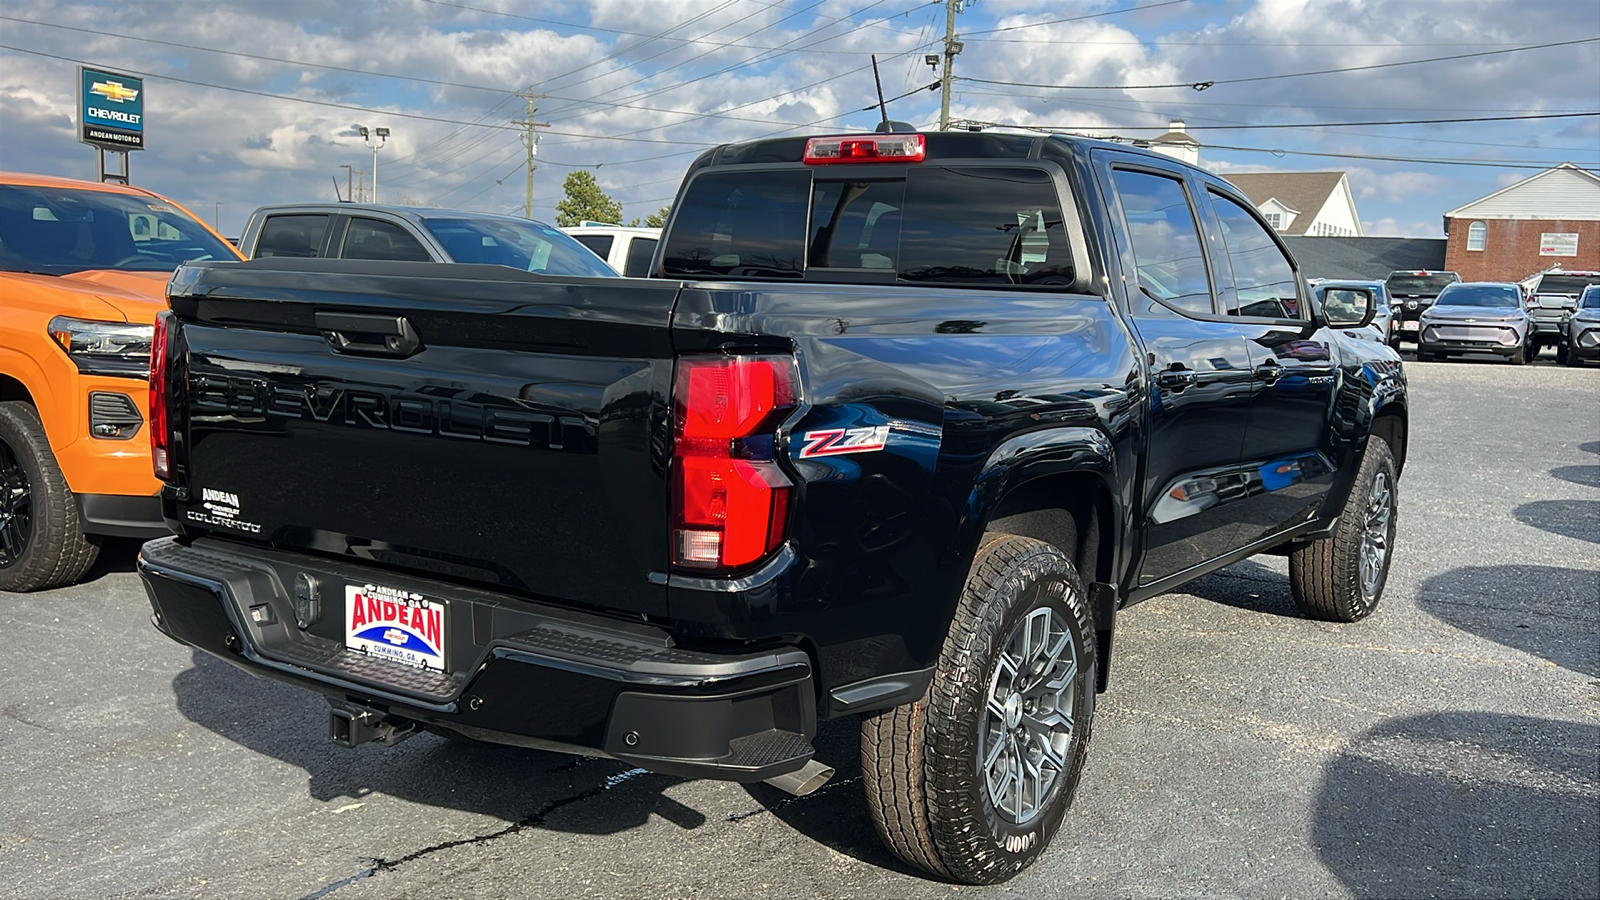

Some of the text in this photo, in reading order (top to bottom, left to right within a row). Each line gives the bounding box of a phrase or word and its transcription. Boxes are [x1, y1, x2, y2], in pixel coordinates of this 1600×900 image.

[88, 107, 140, 124] CHEVROLET
[90, 131, 140, 144] ANDEAN MOTOR CO
[203, 488, 240, 508] ANDEAN
[187, 511, 261, 533] COLORADO
[367, 592, 421, 609] CUMMING, GA
[377, 586, 408, 598] ANDEAN
[352, 593, 441, 652] ANDEAN
[386, 632, 406, 641] CHEVROLET
[374, 645, 405, 659] CUMMING,
